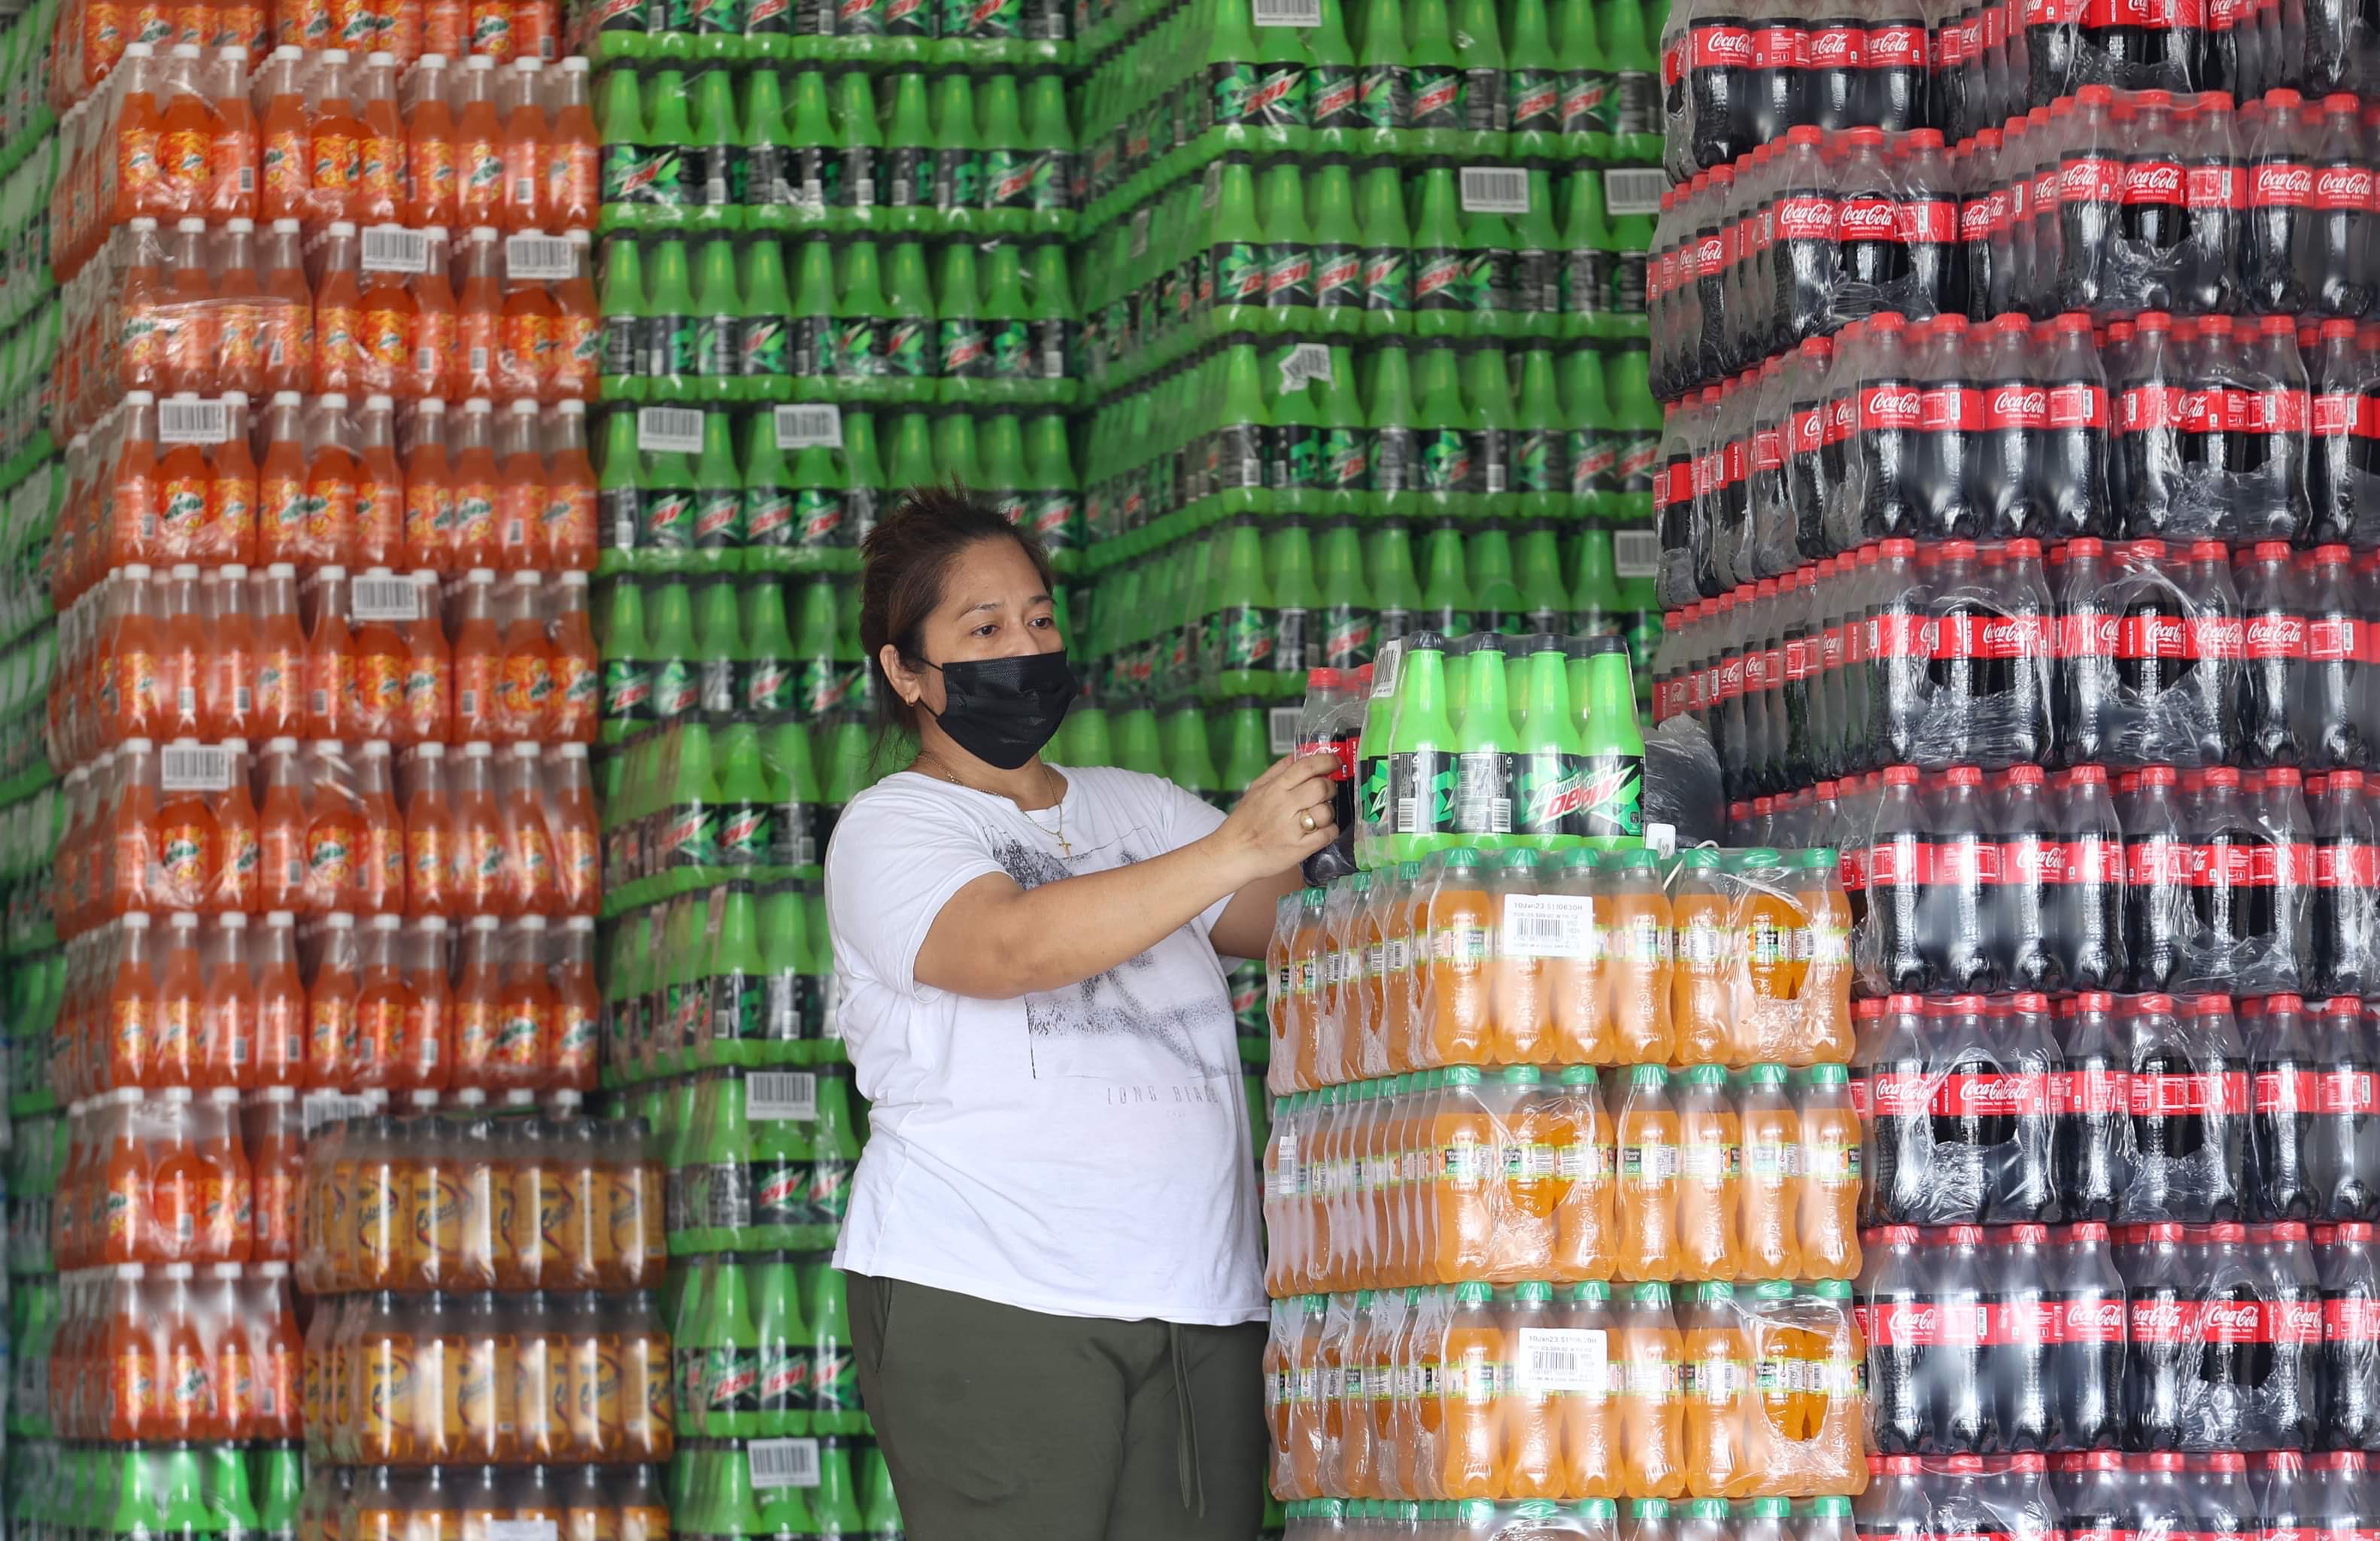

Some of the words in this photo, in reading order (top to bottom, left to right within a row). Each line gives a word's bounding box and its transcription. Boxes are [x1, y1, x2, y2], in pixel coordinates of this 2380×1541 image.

[2125, 168, 2178, 190] Coca-Cola
[2258, 169, 2312, 192] Coca-Cola
[2318, 172, 2371, 194] Coca-Cola
[1781, 203, 1833, 225] Coca-Cola
[1841, 204, 1893, 226] Coca-Cola
[1870, 392, 1920, 415] Coca-Cola
[1994, 391, 2045, 415] Coca-Cola
[2248, 622, 2303, 643] Coca-Cola
[2068, 1305, 2122, 1327] Coca-Cola
[2208, 1305, 2258, 1327] Coca-Cola
